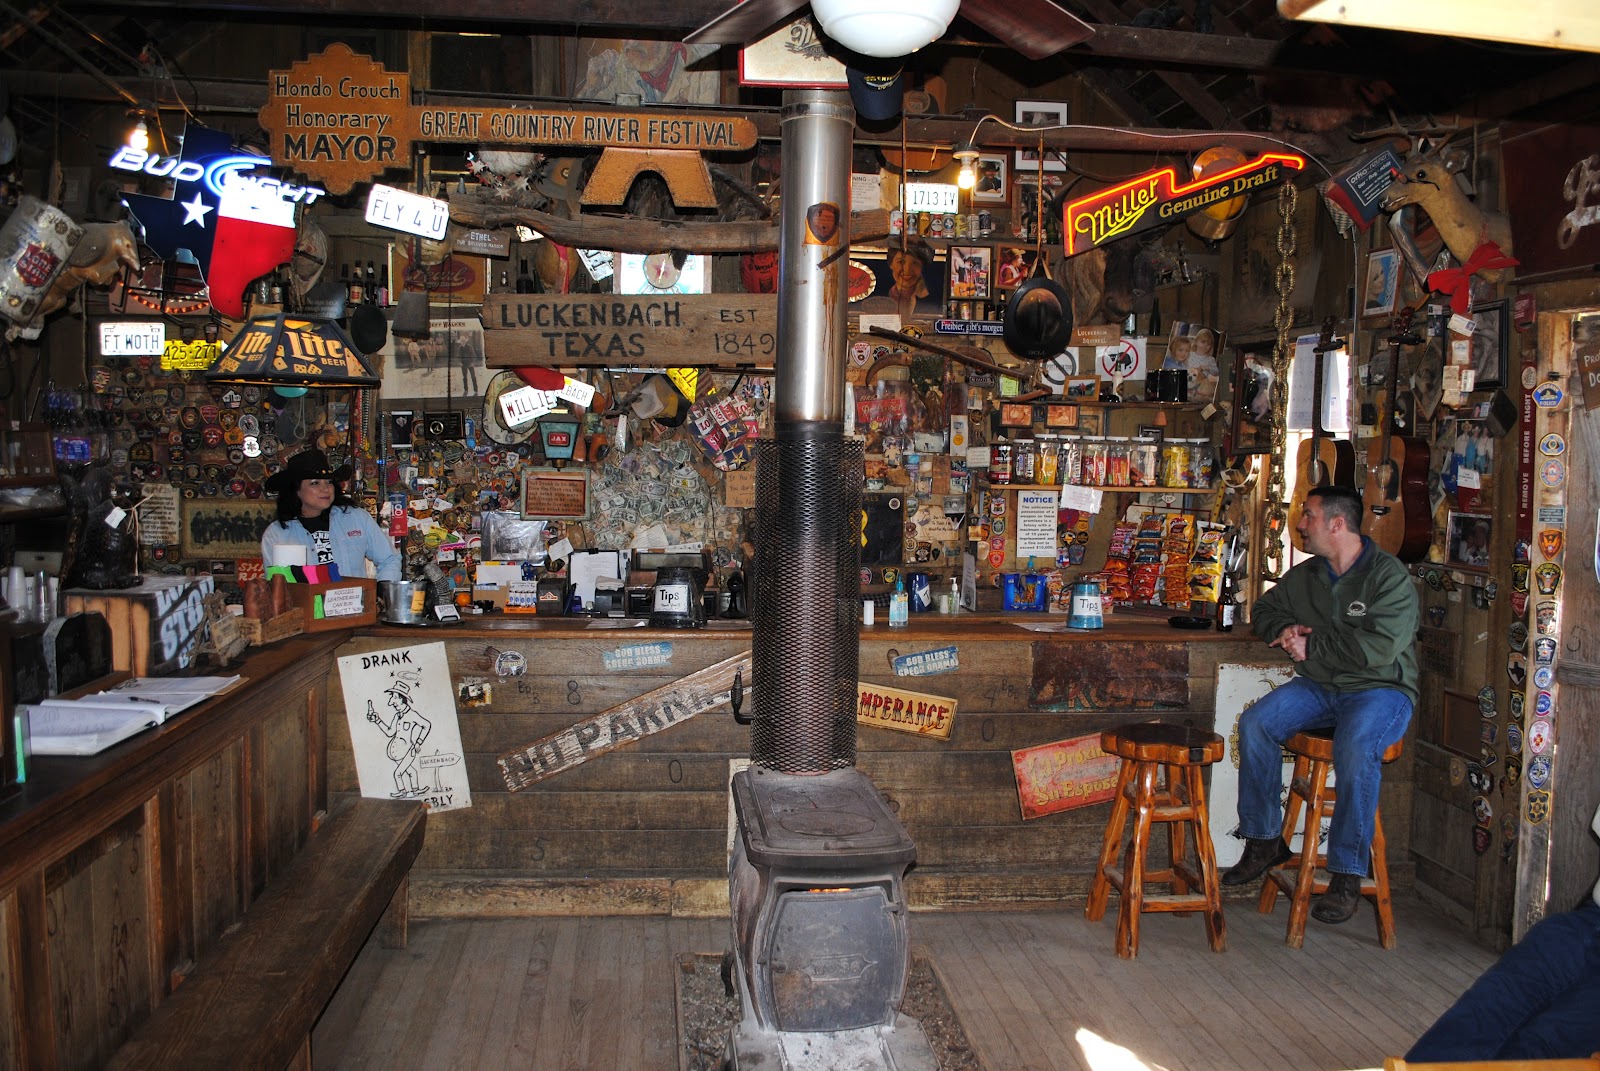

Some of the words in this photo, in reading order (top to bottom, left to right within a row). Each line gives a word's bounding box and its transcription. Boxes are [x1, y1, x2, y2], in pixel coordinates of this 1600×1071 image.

[275, 75, 332, 97] Hondo
[339, 76, 401, 99] Crouch
[286, 104, 391, 134] Honorary
[420, 111, 483, 138] GREAT
[490, 113, 576, 142] COUNTRY
[584, 116, 640, 143] RIVER
[647, 119, 739, 147] FESTIVAL
[284, 133, 398, 163] MAYOR
[110, 147, 205, 182] BUD
[913, 190, 939, 206] 1713
[1074, 179, 1159, 242] Miller
[1159, 188, 1229, 219] Genuine
[1233, 166, 1278, 192] Draft
[372, 199, 405, 223] FLY
[413, 209, 422, 227] 4
[432, 215, 443, 232] U
[470, 231, 492, 241] ETHEL
[19, 261, 48, 280] STAR
[26, 251, 53, 273] LONE
[501, 302, 680, 328] LUCKENBACH
[720, 309, 758, 323] EST
[104, 334, 121, 350] FT
[125, 334, 159, 350] WOTH
[235, 331, 273, 360] Lite
[285, 331, 344, 363] Lite
[541, 332, 645, 357] TEXAS
[714, 333, 775, 355] 1849
[321, 357, 346, 367] BEER
[505, 391, 554, 419] WILLIE
[1523, 393, 1531, 423] FLIGHT
[1522, 430, 1530, 464] BEFORE
[1023, 496, 1054, 504] NOTICE
[1521, 472, 1529, 509] REMOVE
[391, 504, 404, 517] 18
[660, 589, 680, 604] Tips
[1080, 597, 1099, 612] Tips
[361, 650, 412, 670] DRANK
[615, 647, 633, 659] GOD
[634, 645, 661, 656] BLESS
[906, 655, 924, 667] GOD
[925, 650, 949, 662] BLESS
[857, 690, 950, 730] MPERANCE
[421, 756, 455, 765] LUCKENBACH
